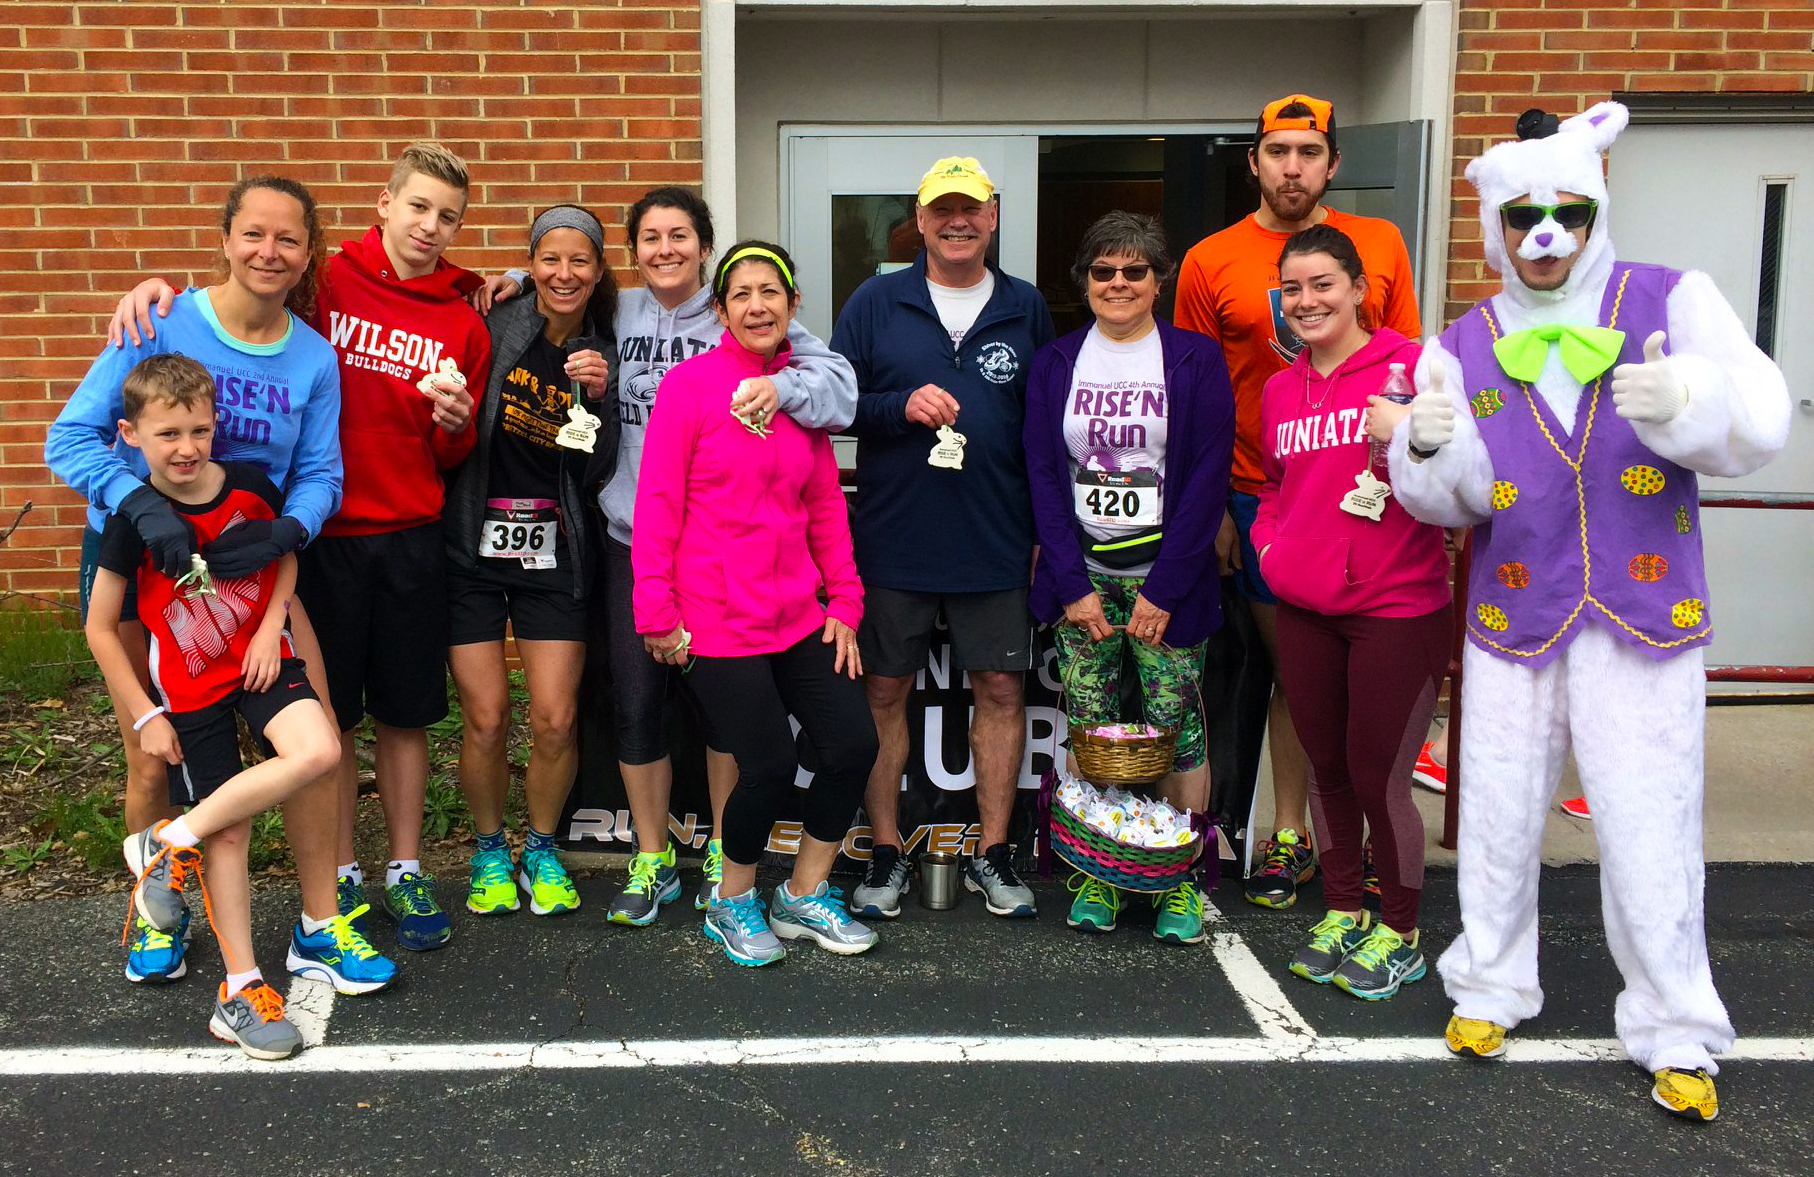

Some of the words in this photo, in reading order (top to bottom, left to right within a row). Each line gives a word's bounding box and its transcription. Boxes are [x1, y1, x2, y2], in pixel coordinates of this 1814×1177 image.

[329, 310, 444, 374] WILSON
[236, 368, 251, 378] UCC
[253, 371, 266, 382] 2nd
[345, 352, 412, 380] BULLDOGS
[506, 367, 531, 386] ARK
[216, 374, 291, 415] ISE'N
[1077, 380, 1113, 390] Immanuel
[1113, 381, 1128, 390] UCC
[1128, 381, 1140, 389] 4th
[1073, 388, 1164, 417] RISE'N
[215, 404, 271, 446] Run
[1087, 417, 1146, 448] Run
[1085, 488, 1140, 517] 420
[492, 525, 545, 551] 396
